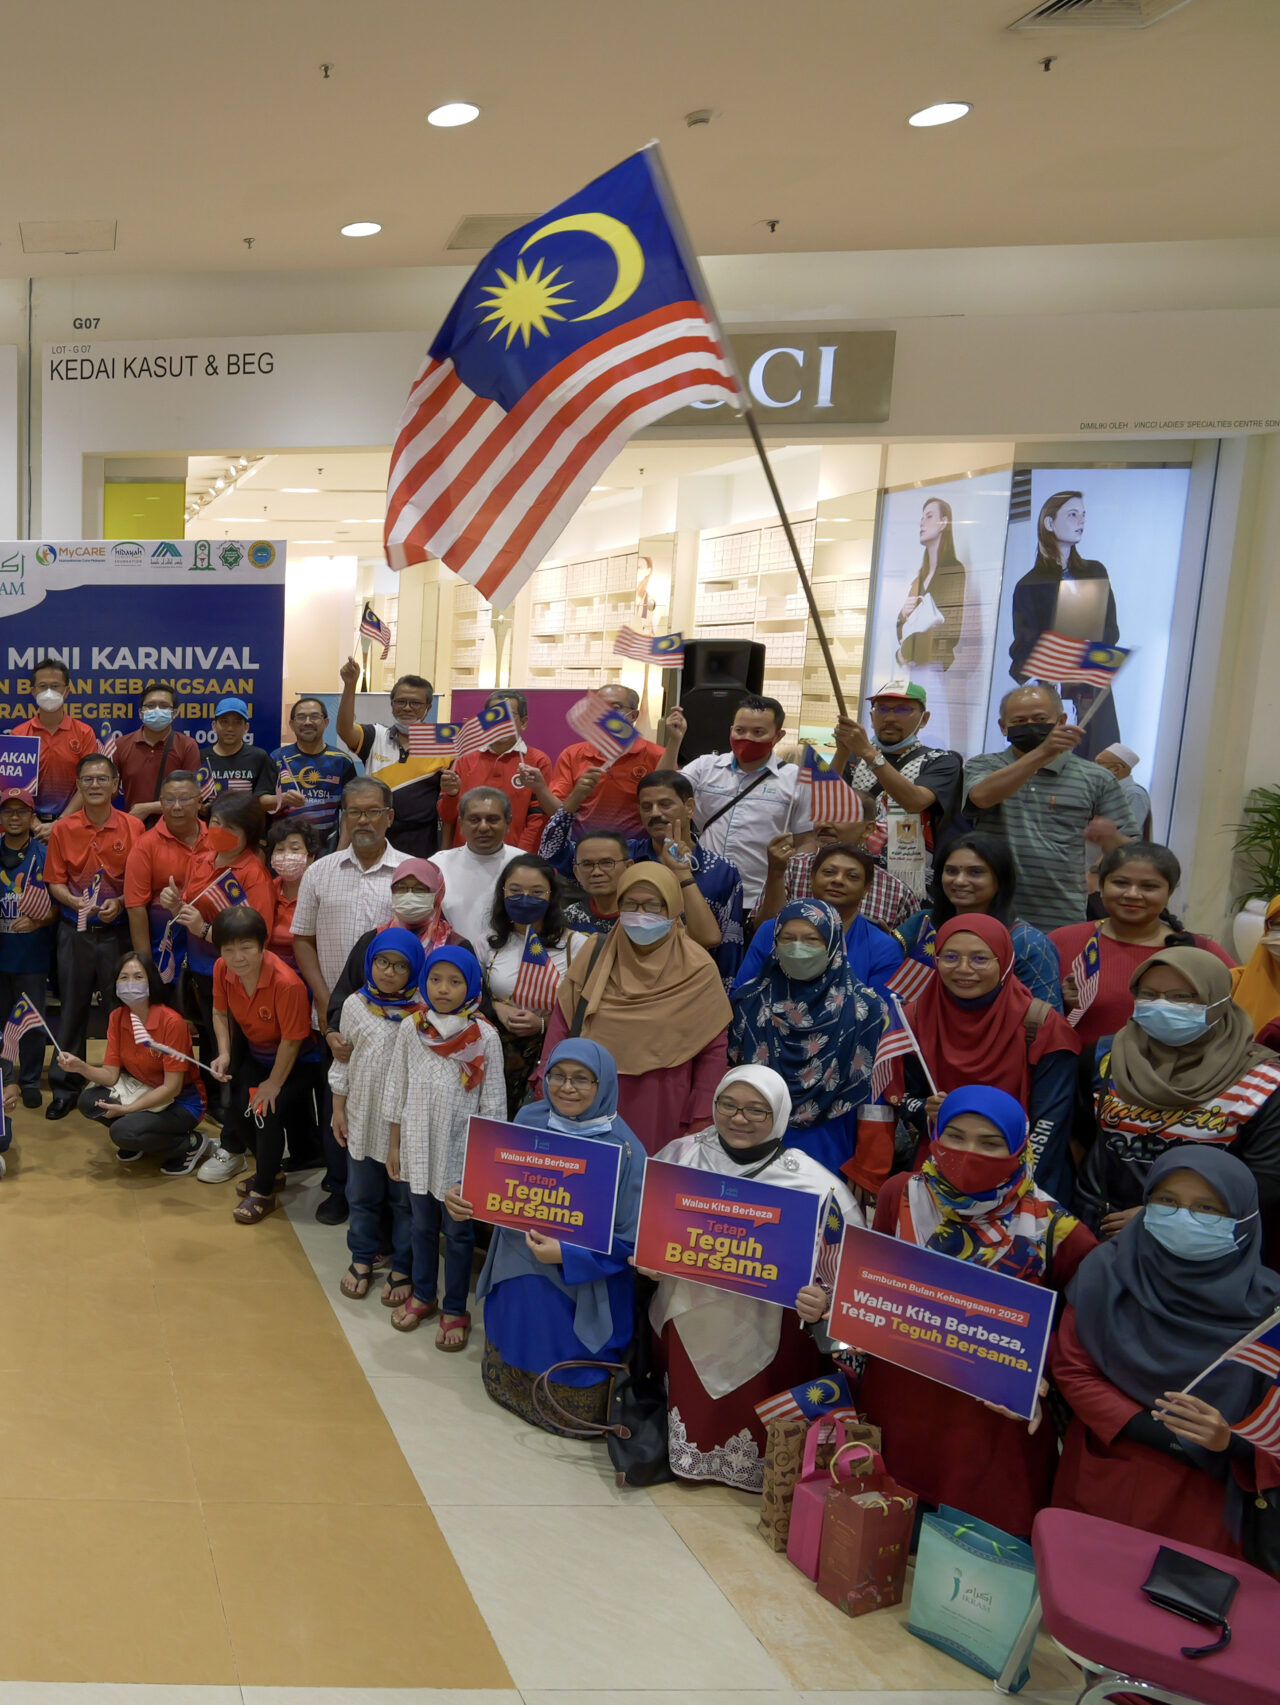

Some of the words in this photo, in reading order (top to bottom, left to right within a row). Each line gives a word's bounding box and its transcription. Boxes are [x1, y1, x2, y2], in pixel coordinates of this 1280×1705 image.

[73, 318, 100, 329] G07
[52, 346, 67, 354] LOT
[50, 358, 115, 381] KEDAI
[123, 355, 198, 379] KASUT
[205, 354, 219, 376] &
[227, 352, 274, 375] BEG
[1109, 422, 1128, 430] OLEH
[1233, 420, 1263, 428] CENTRE
[59, 546, 106, 558] MyCARE
[8, 647, 80, 670] MINI
[91, 647, 260, 670] KARNIVAL
[17, 678, 92, 695] BAN
[0, 752, 37, 764] AKAN
[211, 769, 253, 779] ALAYSIA
[500, 1151, 525, 1162] Walau
[526, 1155, 543, 1165] Kita
[544, 1158, 580, 1170] Berbeza
[523, 1171, 557, 1188] Tetap
[505, 1179, 571, 1207] Teguh
[486, 1192, 584, 1226] Bersama
[682, 1198, 710, 1210] Walau
[711, 1202, 730, 1213] Kita
[732, 1205, 773, 1219] Berbeza
[707, 1219, 747, 1239] Tetap
[686, 1227, 763, 1259] Teguh
[664, 1242, 778, 1281] Bersama
[861, 1270, 907, 1290] Sambutan
[909, 1284, 935, 1298] Bulan
[936, 1291, 996, 1315] Kebangsaan
[998, 1309, 1024, 1323] 2022
[853, 1289, 902, 1315] Walau
[906, 1305, 942, 1327] Kita
[945, 1317, 1026, 1354] Berbeza,
[840, 1302, 886, 1327] Tetap
[891, 1316, 943, 1344] Teguh
[945, 1334, 1033, 1373] Bersama.
